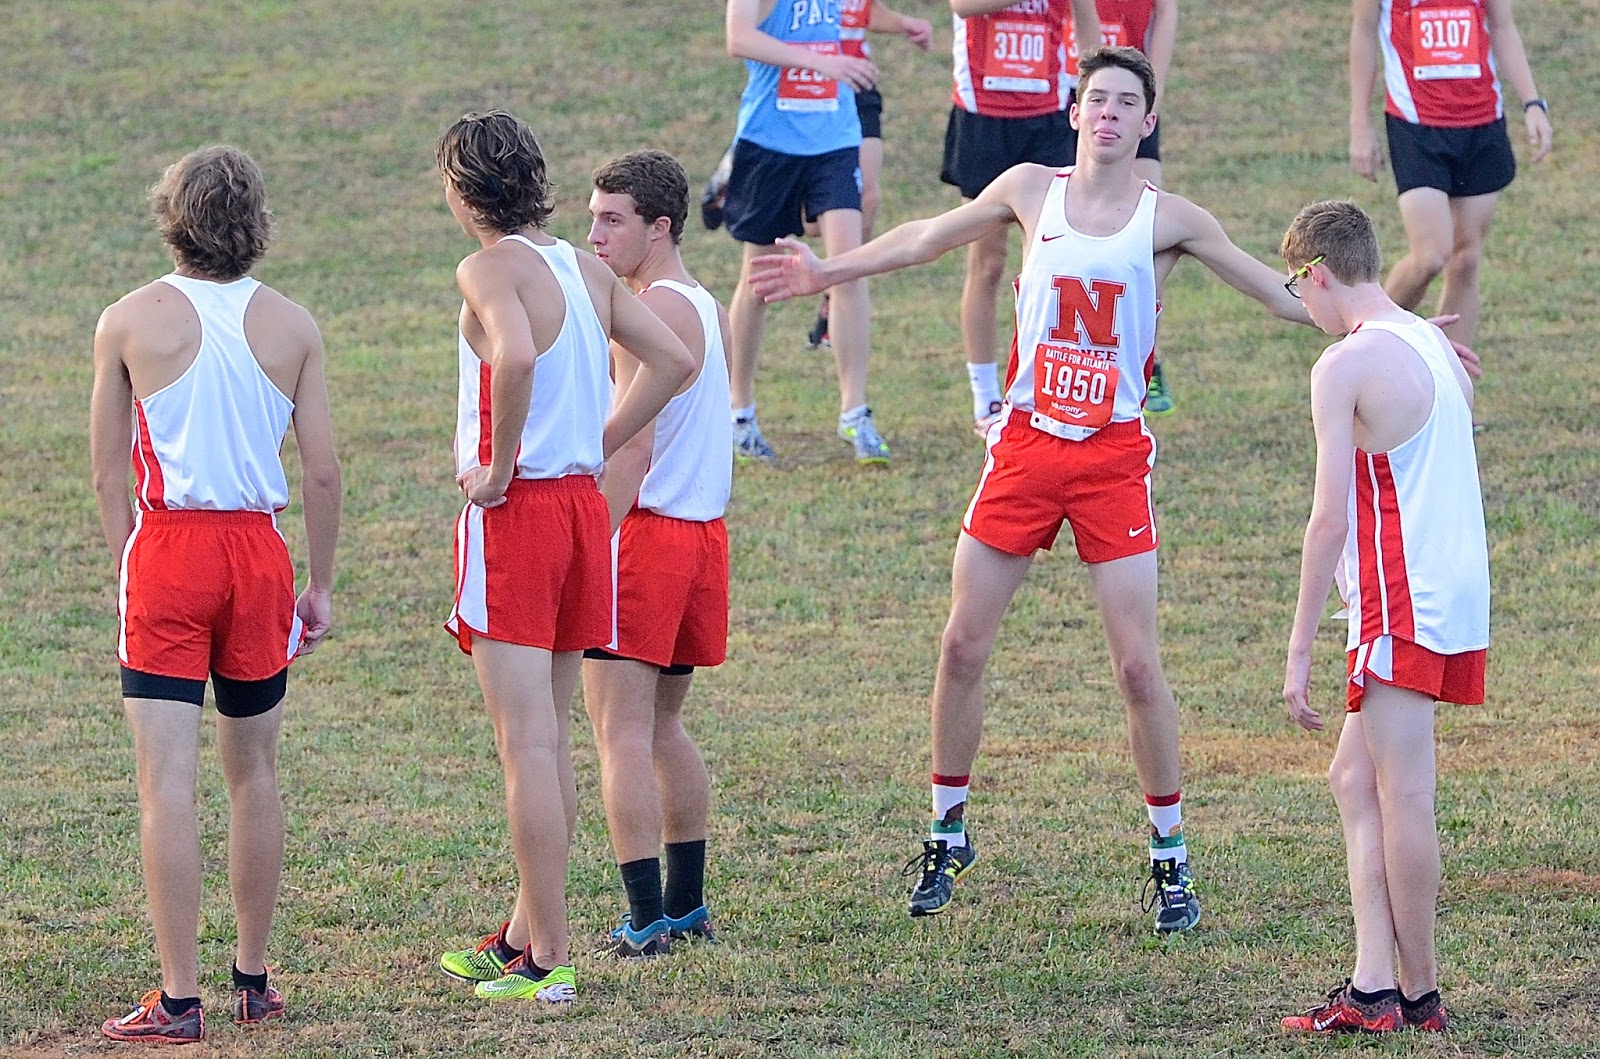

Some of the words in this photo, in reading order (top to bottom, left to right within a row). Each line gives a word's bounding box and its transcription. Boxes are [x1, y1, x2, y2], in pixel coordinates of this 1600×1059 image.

[994, 32, 1045, 62] 3100
[1420, 19, 1472, 48] 3107
[1048, 274, 1127, 348] N
[1045, 348, 1069, 362] BATTLE
[1068, 353, 1082, 365] FOR
[1081, 357, 1111, 371] ATLANTA
[1041, 361, 1107, 405] 1950
[1051, 401, 1082, 415] saucony
